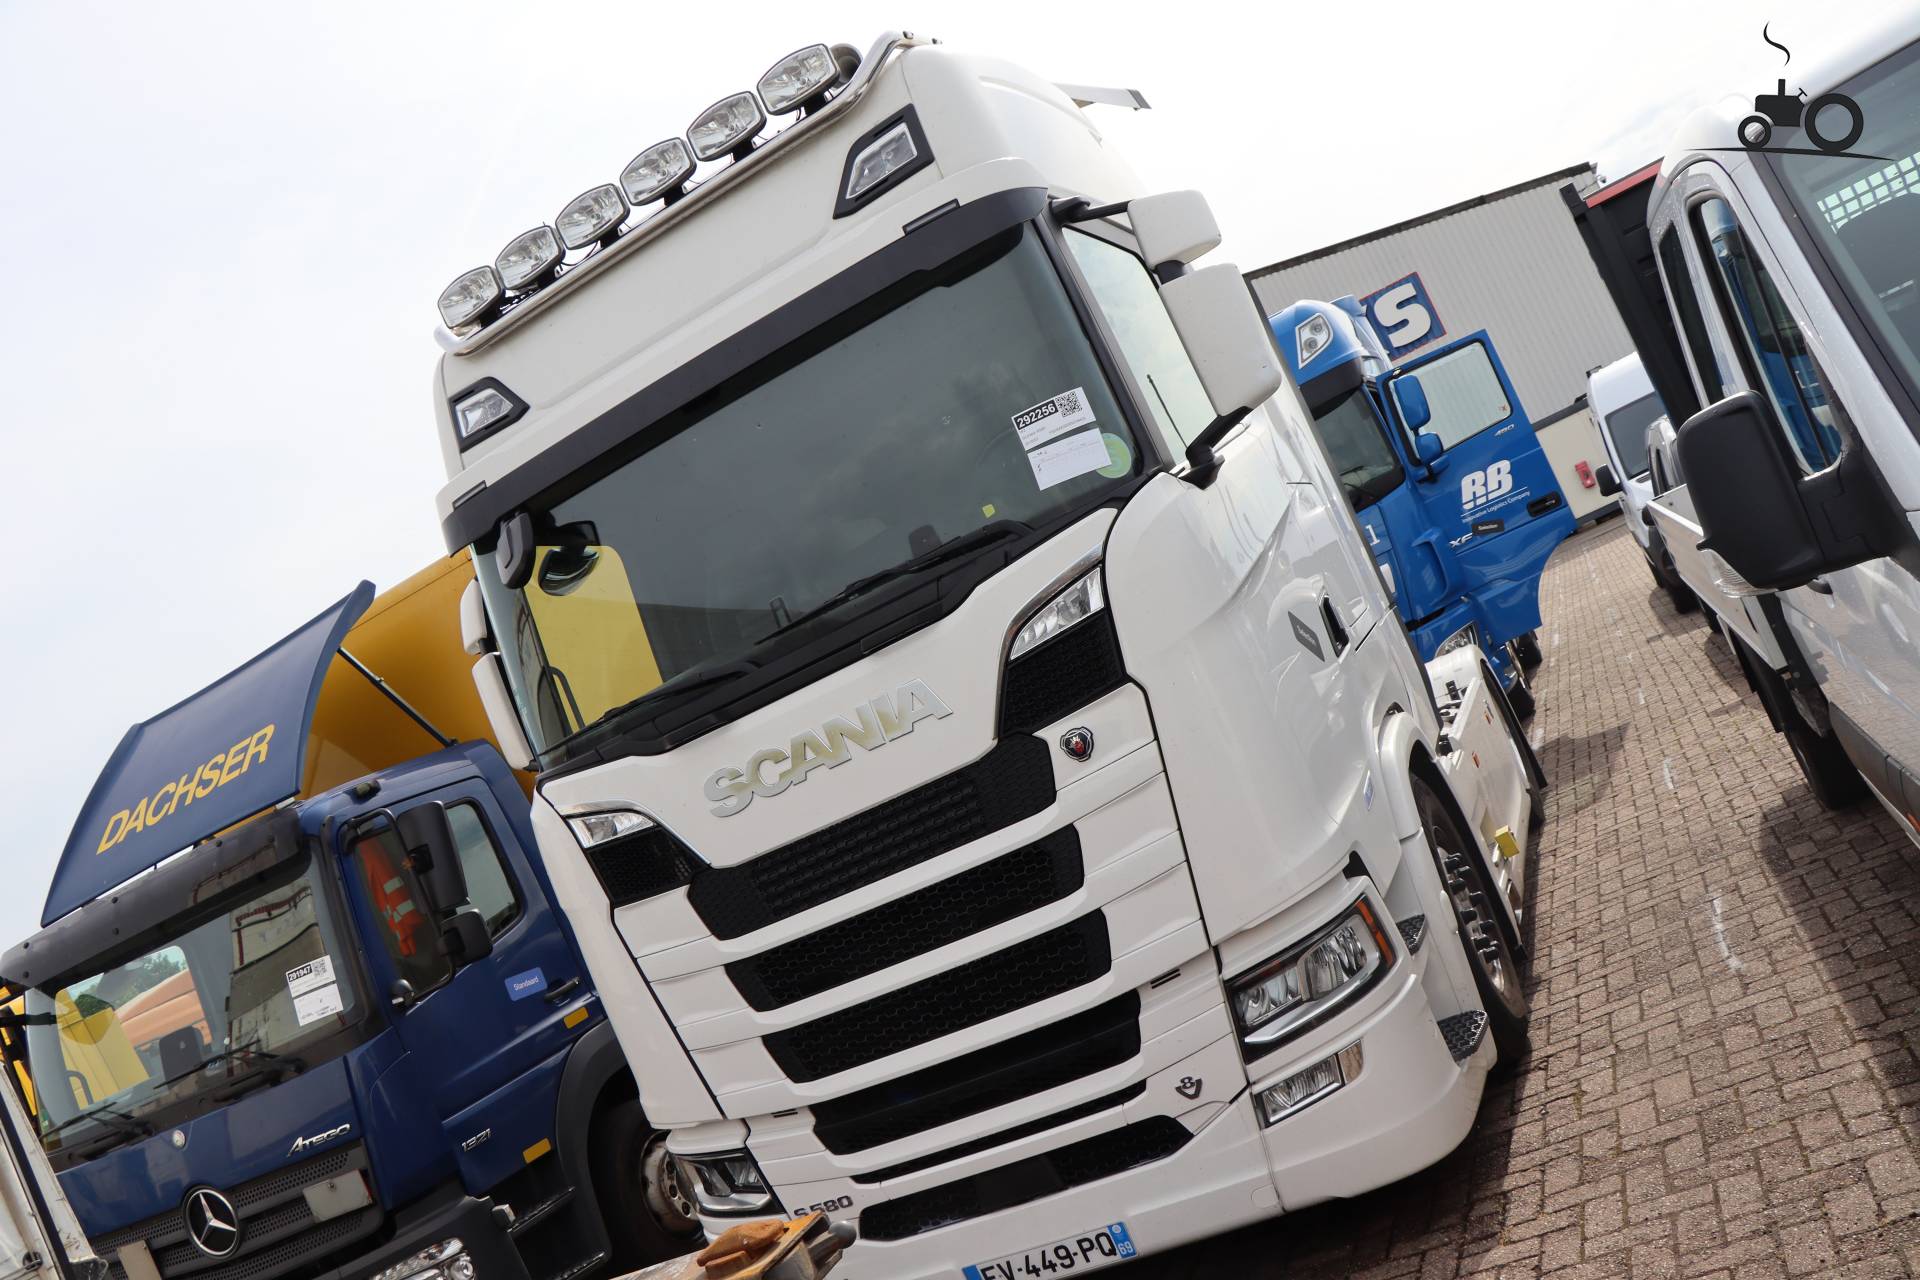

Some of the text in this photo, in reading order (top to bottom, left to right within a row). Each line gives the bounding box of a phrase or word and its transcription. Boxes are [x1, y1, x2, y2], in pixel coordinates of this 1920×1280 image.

[1015, 402, 1057, 429] 292256
[1461, 459, 1512, 510] RB
[1507, 490, 1531, 505] Company
[1449, 532, 1473, 548] XF
[703, 678, 953, 818] SCANIA
[96, 722, 276, 856] DACHSER
[1118, 1240, 1135, 1256] 69
